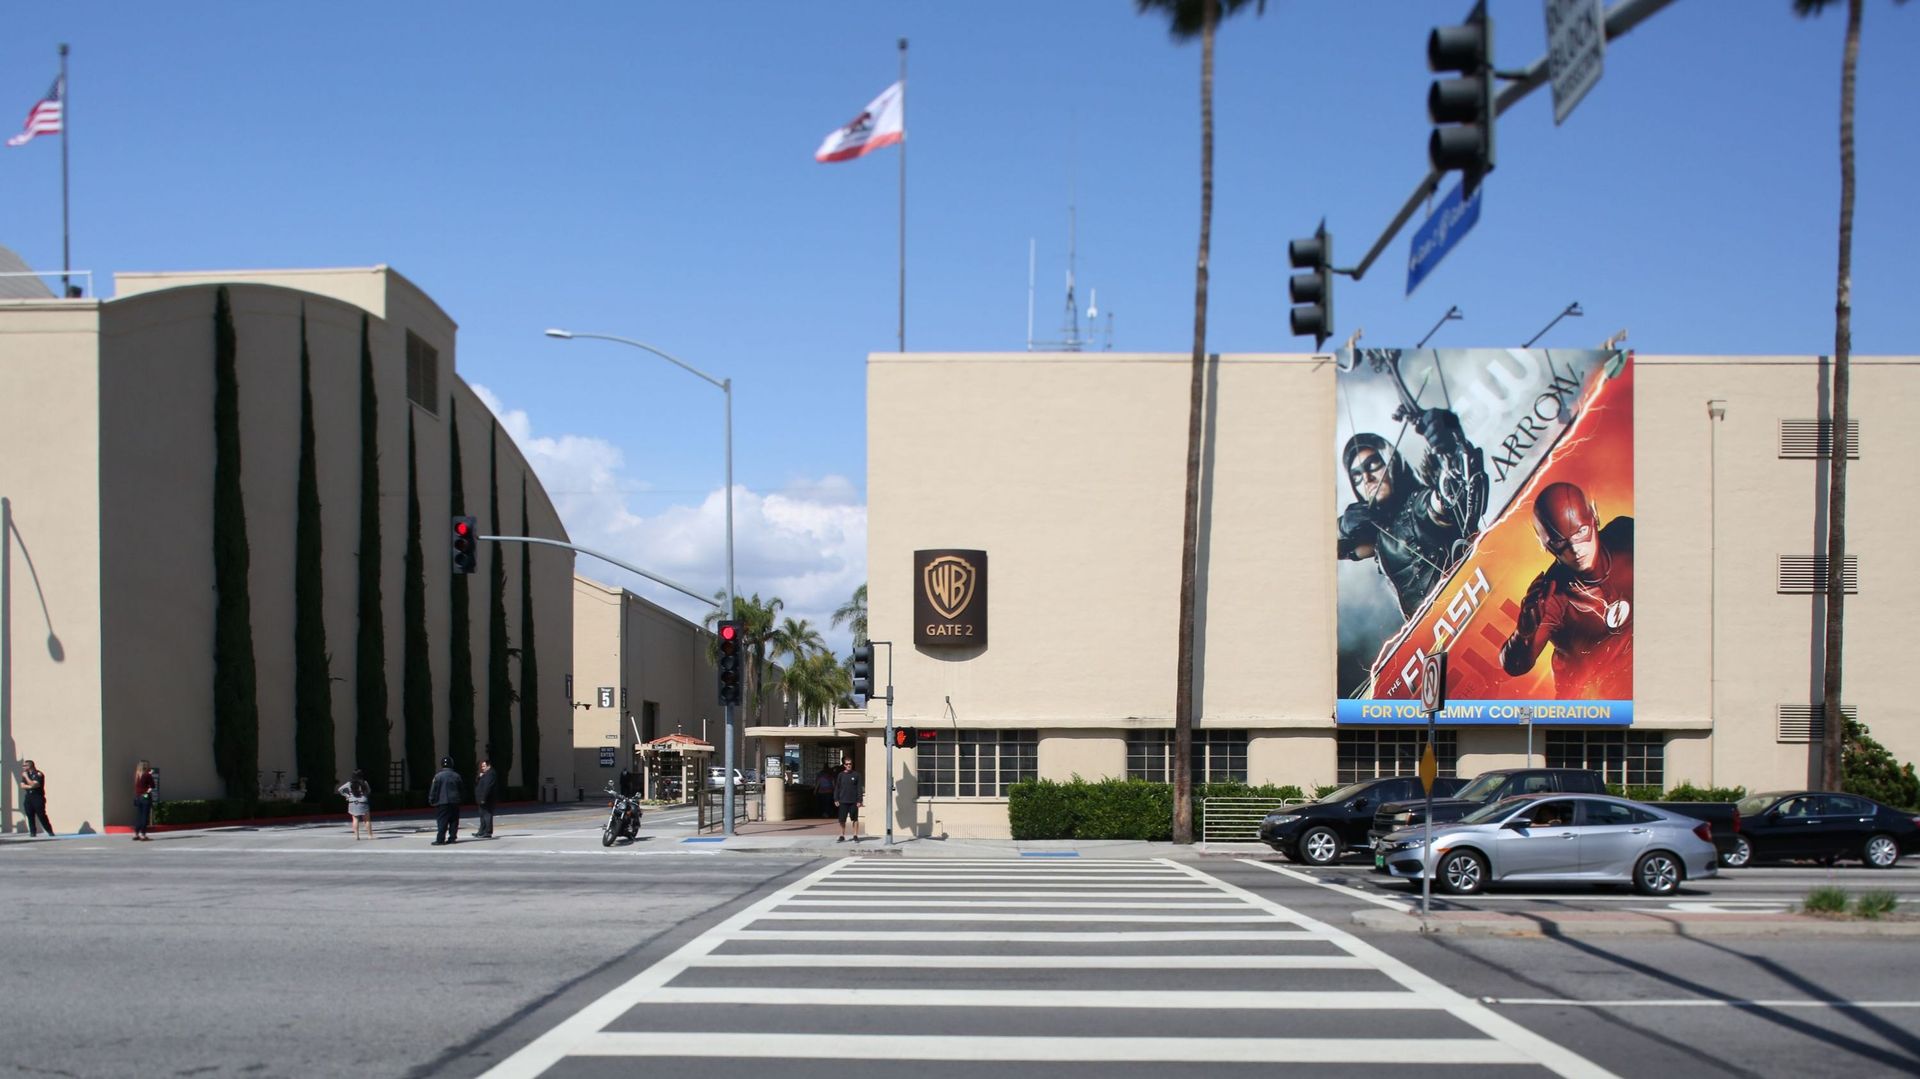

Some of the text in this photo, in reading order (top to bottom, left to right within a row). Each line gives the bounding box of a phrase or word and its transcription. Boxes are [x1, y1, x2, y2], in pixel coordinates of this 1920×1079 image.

[1490, 362, 1584, 482] ARROW
[932, 564, 967, 608] WB
[926, 624, 974, 636] GATE 2
[1386, 678, 1402, 697] THE
[602, 692, 610, 707] 5
[1362, 705, 1392, 719] FOR
[1395, 705, 1429, 719] YOU
[1439, 705, 1483, 719] EMMY
